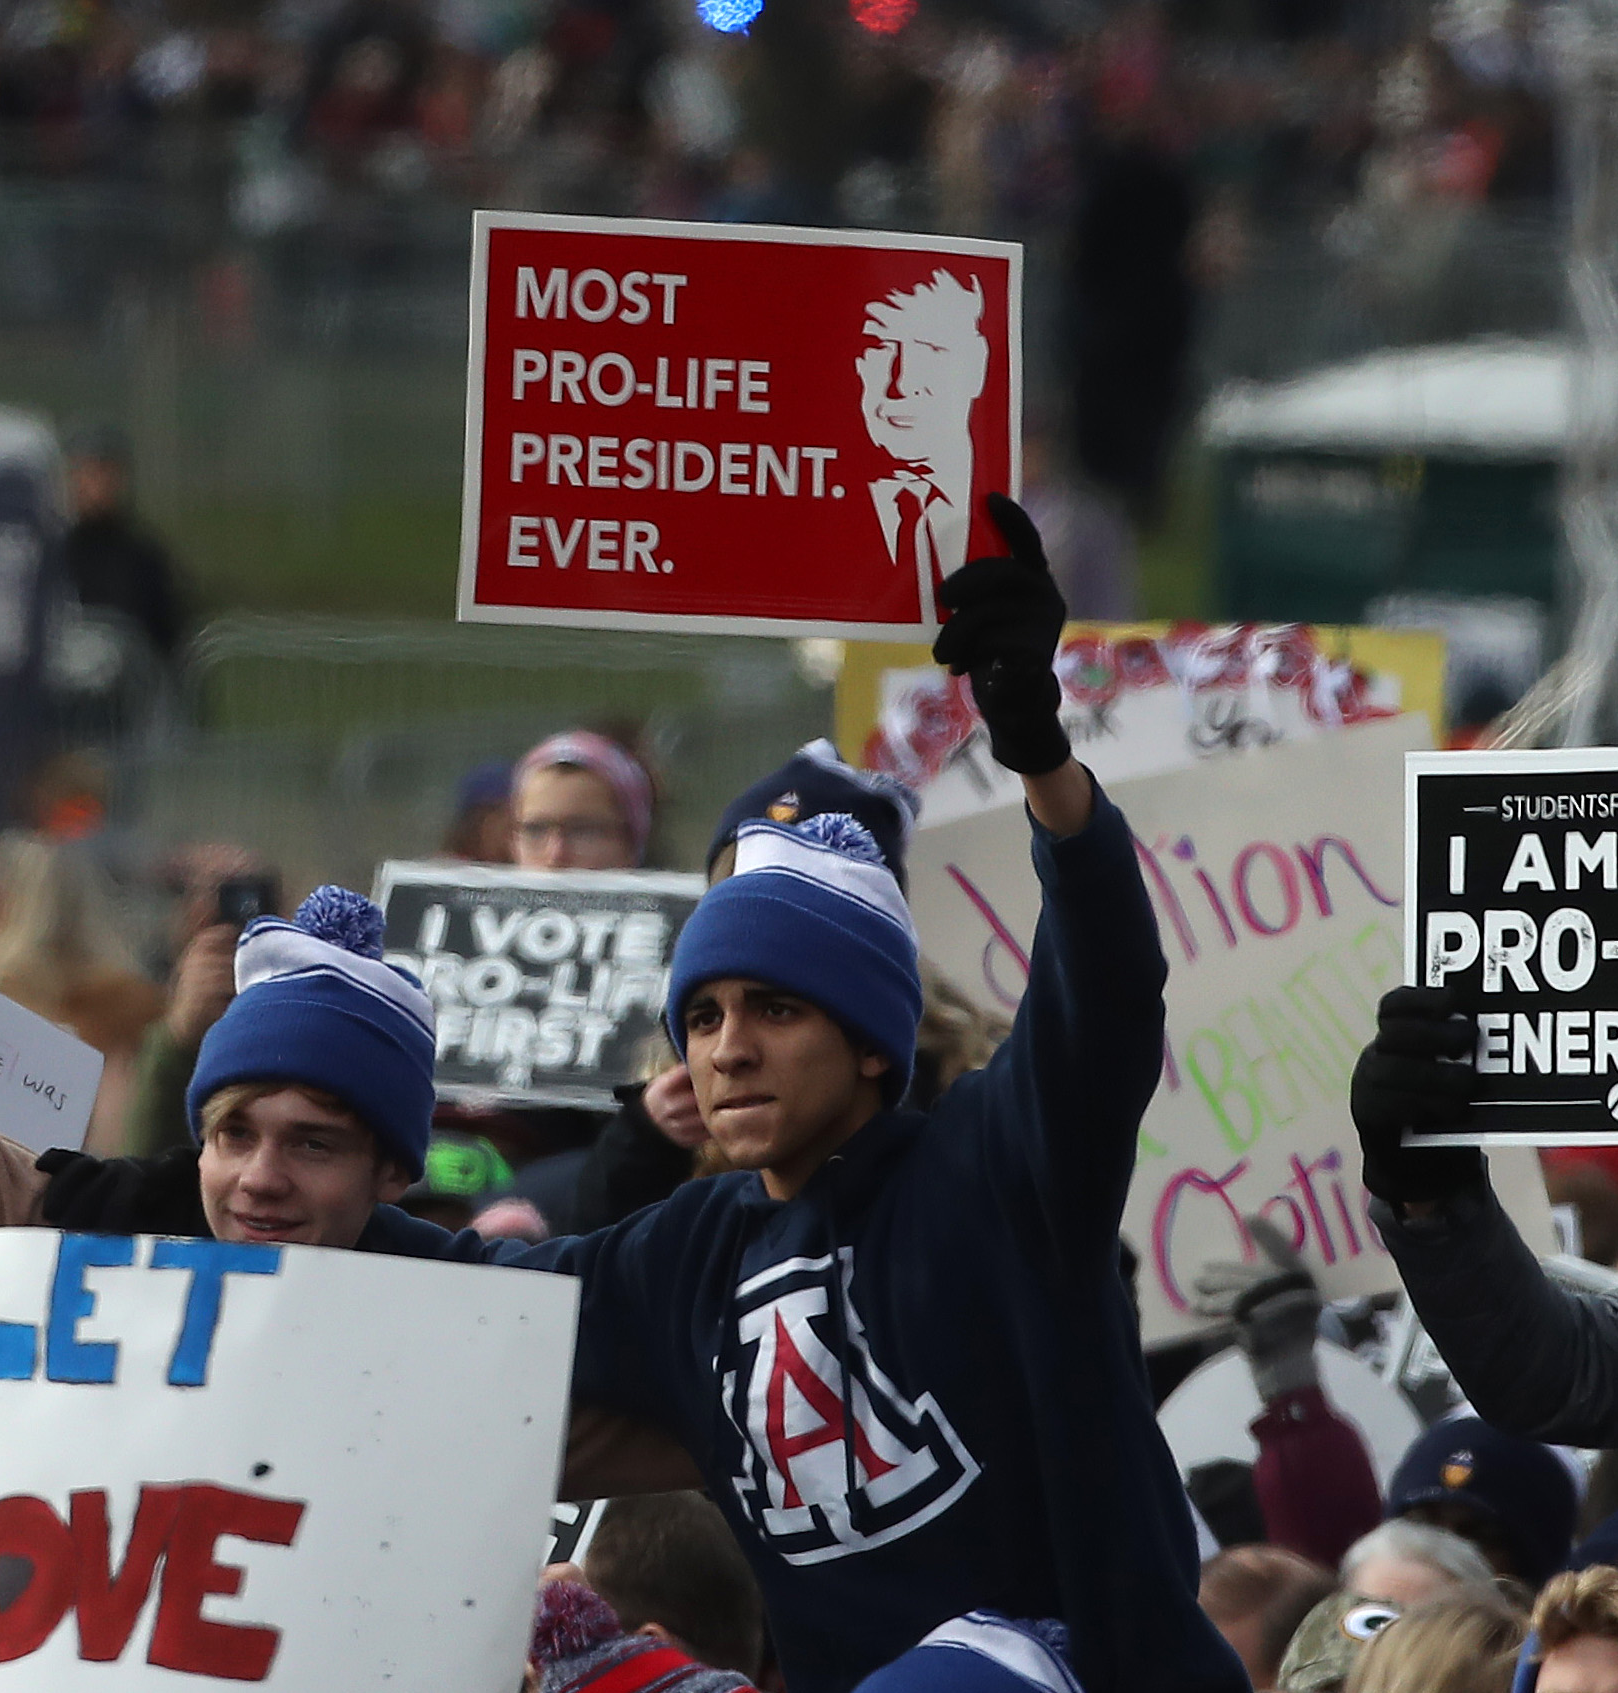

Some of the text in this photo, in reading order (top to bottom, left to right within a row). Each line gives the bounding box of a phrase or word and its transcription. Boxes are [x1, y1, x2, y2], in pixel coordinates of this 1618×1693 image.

[514, 266, 688, 326] MOST
[511, 348, 772, 414] PRO-LIFE
[509, 432, 847, 501] PRESIDENT.
[506, 514, 675, 575] EVER.
[1448, 835, 1467, 895] I
[1502, 830, 1618, 893] AM
[470, 903, 674, 963] VOTE
[383, 950, 673, 1022] PRO-LIF
[434, 1003, 620, 1070] FIRST
[22, 1073, 69, 1112] was
